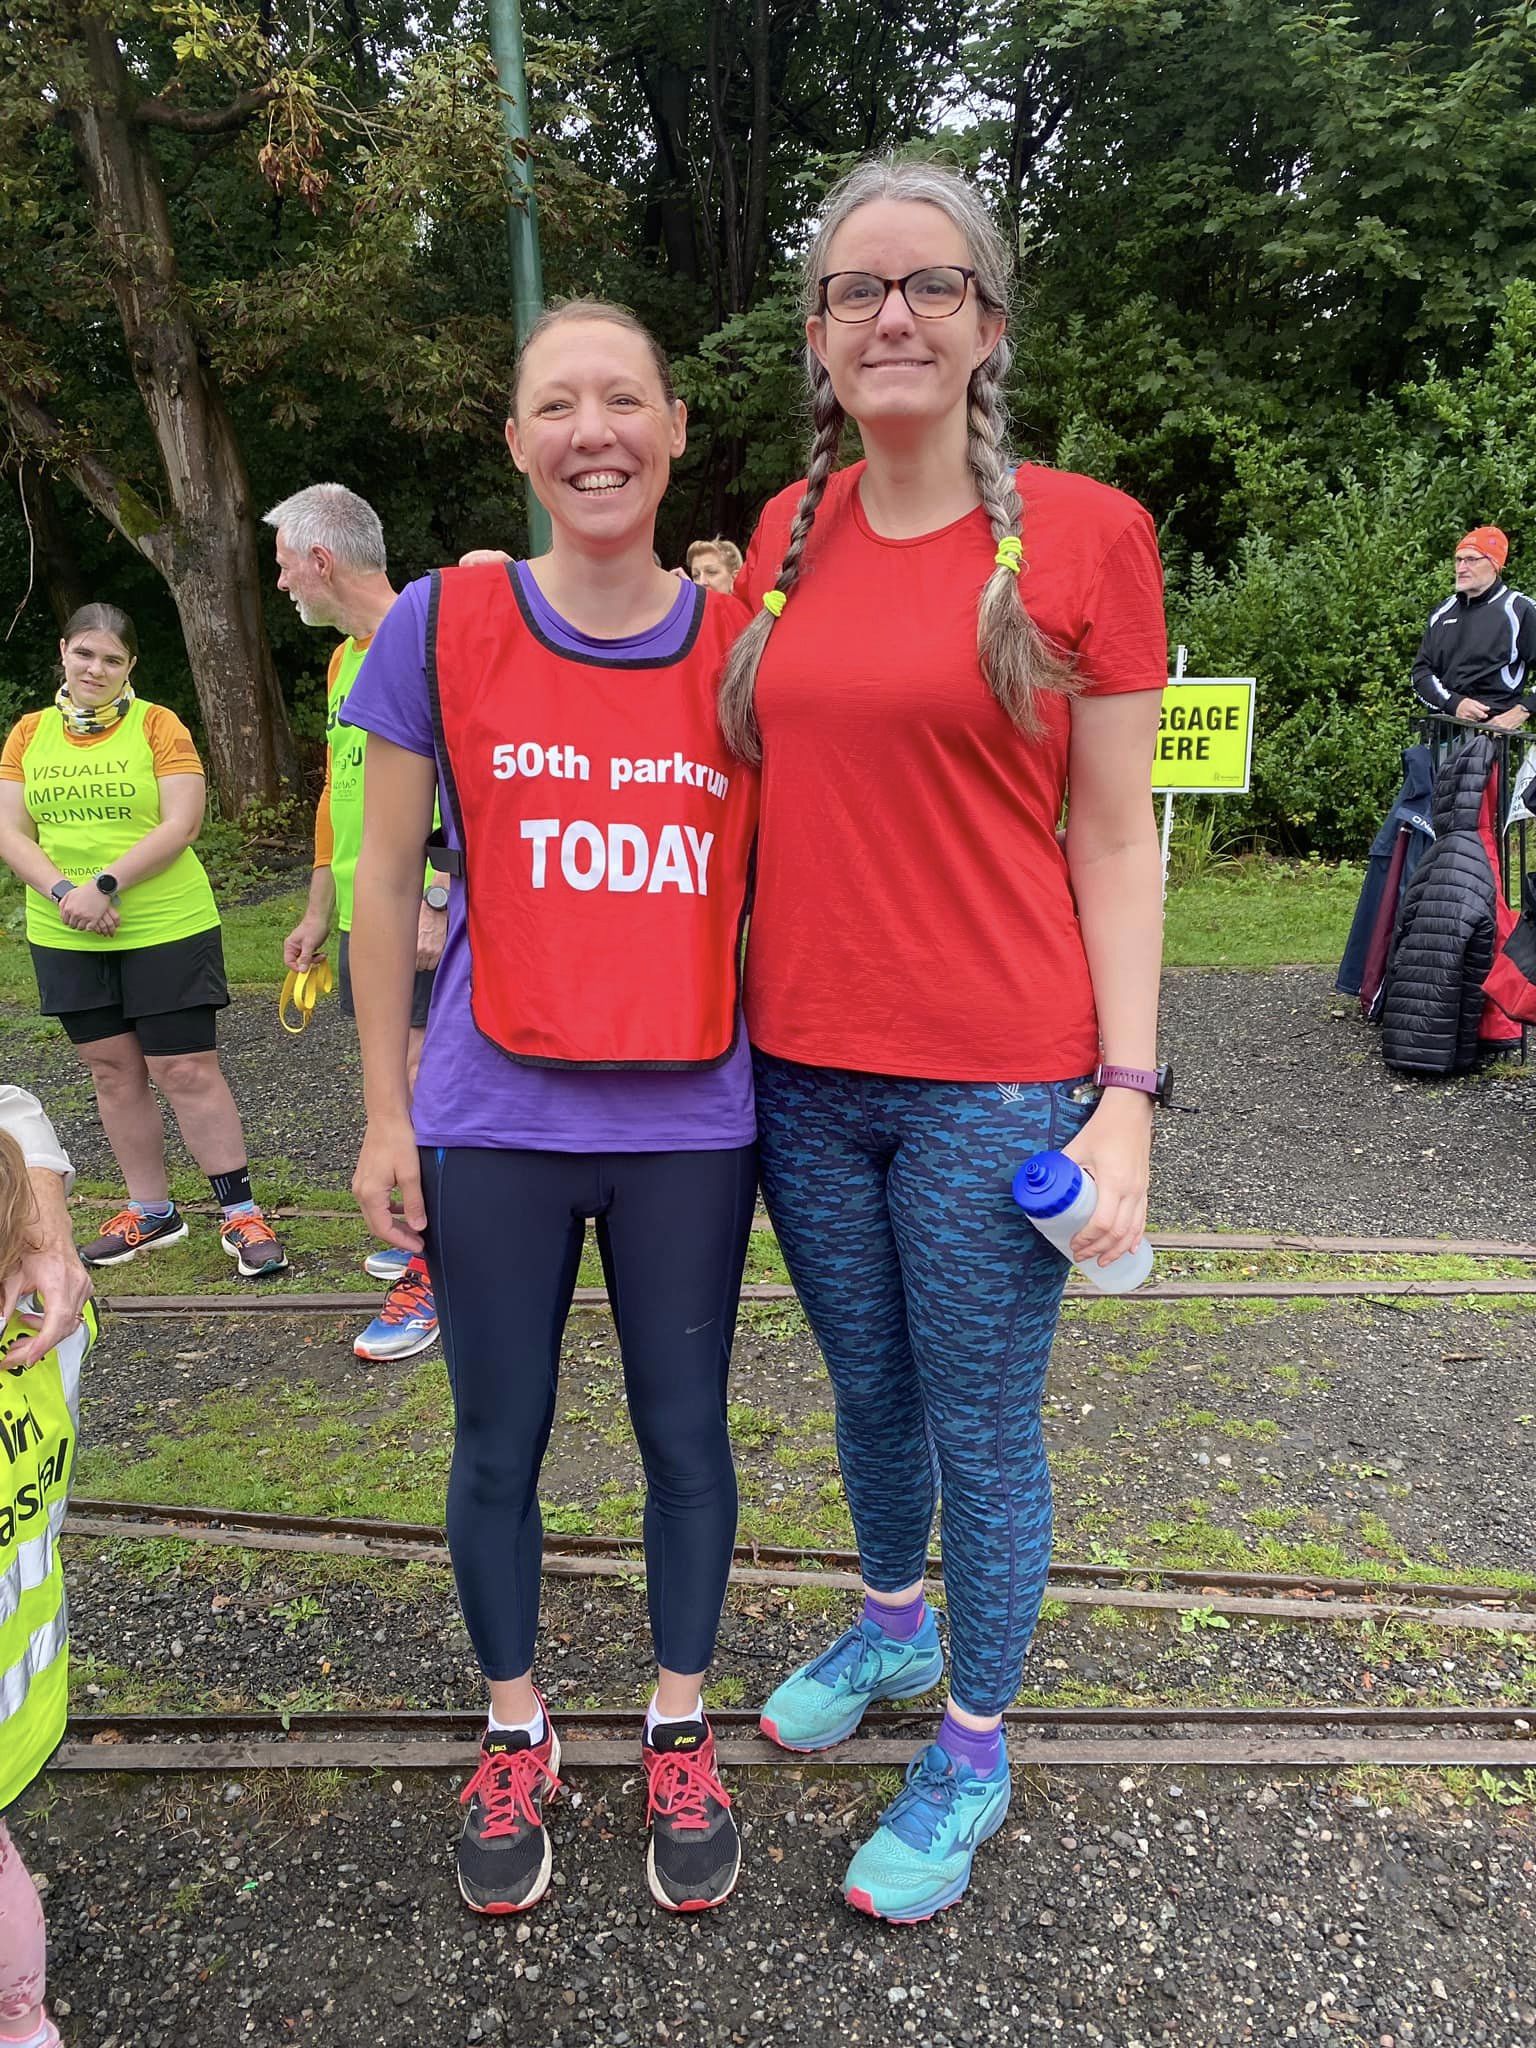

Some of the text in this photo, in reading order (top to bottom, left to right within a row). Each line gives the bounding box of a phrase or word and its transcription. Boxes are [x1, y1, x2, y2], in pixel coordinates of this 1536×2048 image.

[1158, 706, 1240, 731] GGAGE
[1153, 736, 1211, 761] ERE
[33, 760, 129, 781] VISUALLY
[492, 742, 729, 800] 50th parkrun
[28, 782, 136, 806] IMPAIRED
[40, 806, 132, 824] RUNNER
[520, 819, 715, 896] TODAY
[63, 866, 104, 877] FINDAG
